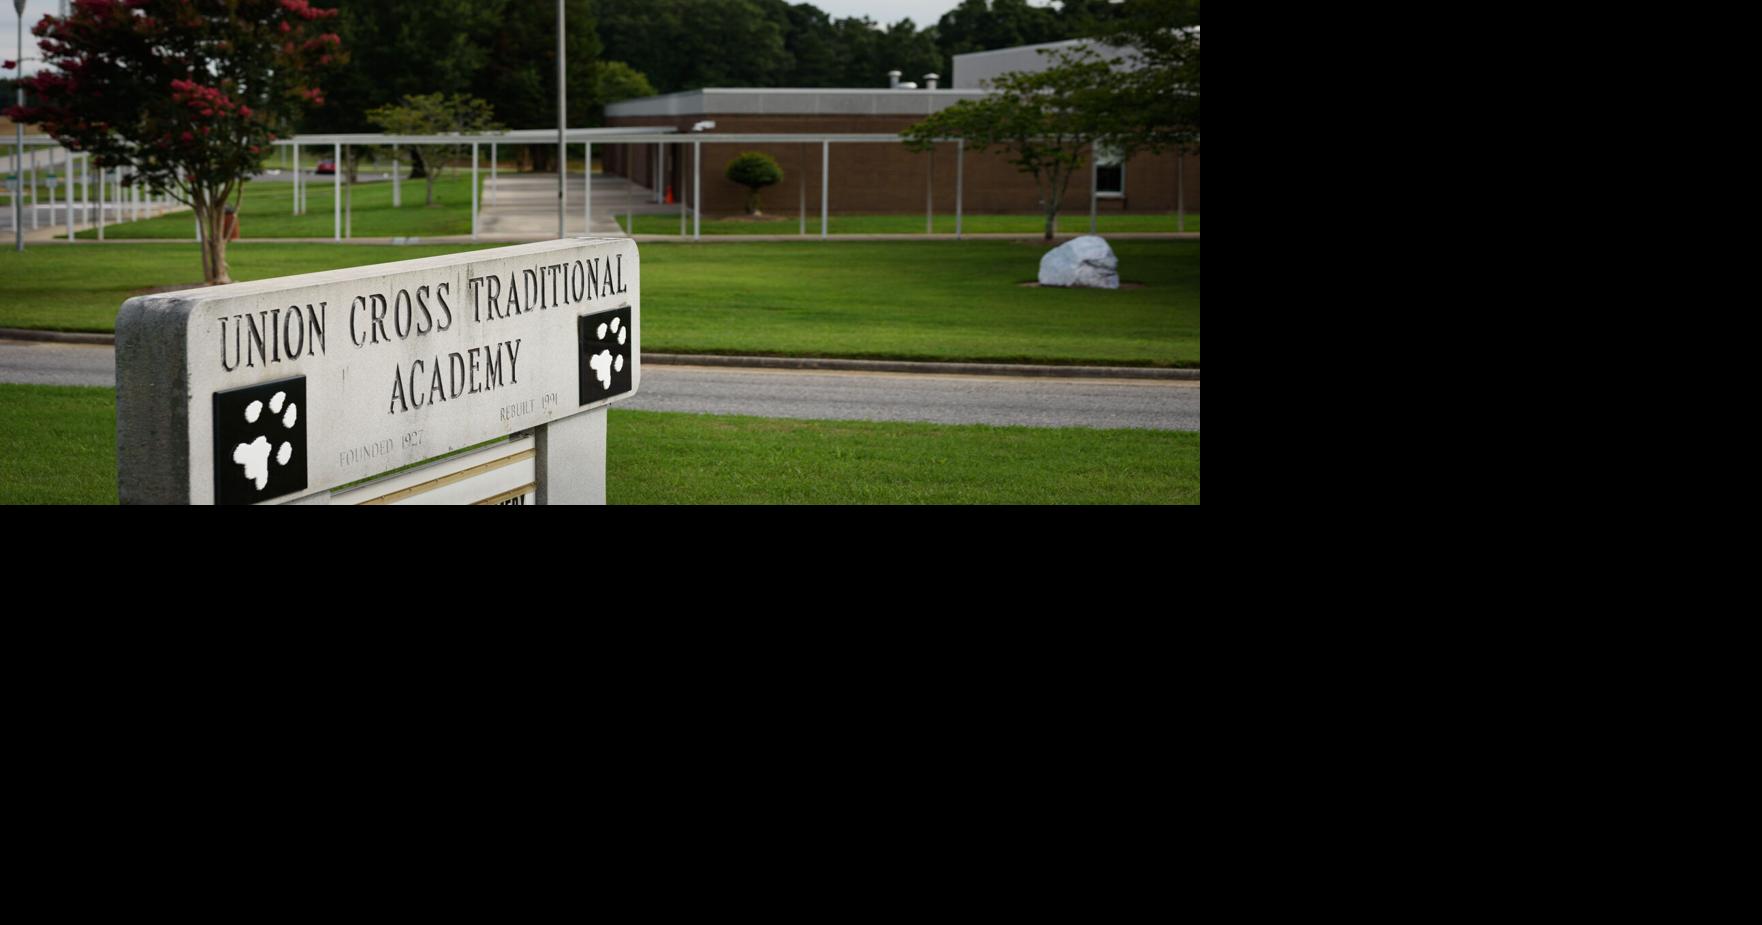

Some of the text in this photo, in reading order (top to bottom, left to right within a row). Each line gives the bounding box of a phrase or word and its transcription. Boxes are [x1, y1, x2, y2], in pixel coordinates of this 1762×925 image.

[217, 254, 627, 372] UNION CROSS TRADITIONAL
[388, 339, 521, 414] ACADEMY
[500, 392, 558, 421] REBUILT 1991
[339, 430, 424, 467] FOUNDED 1927
